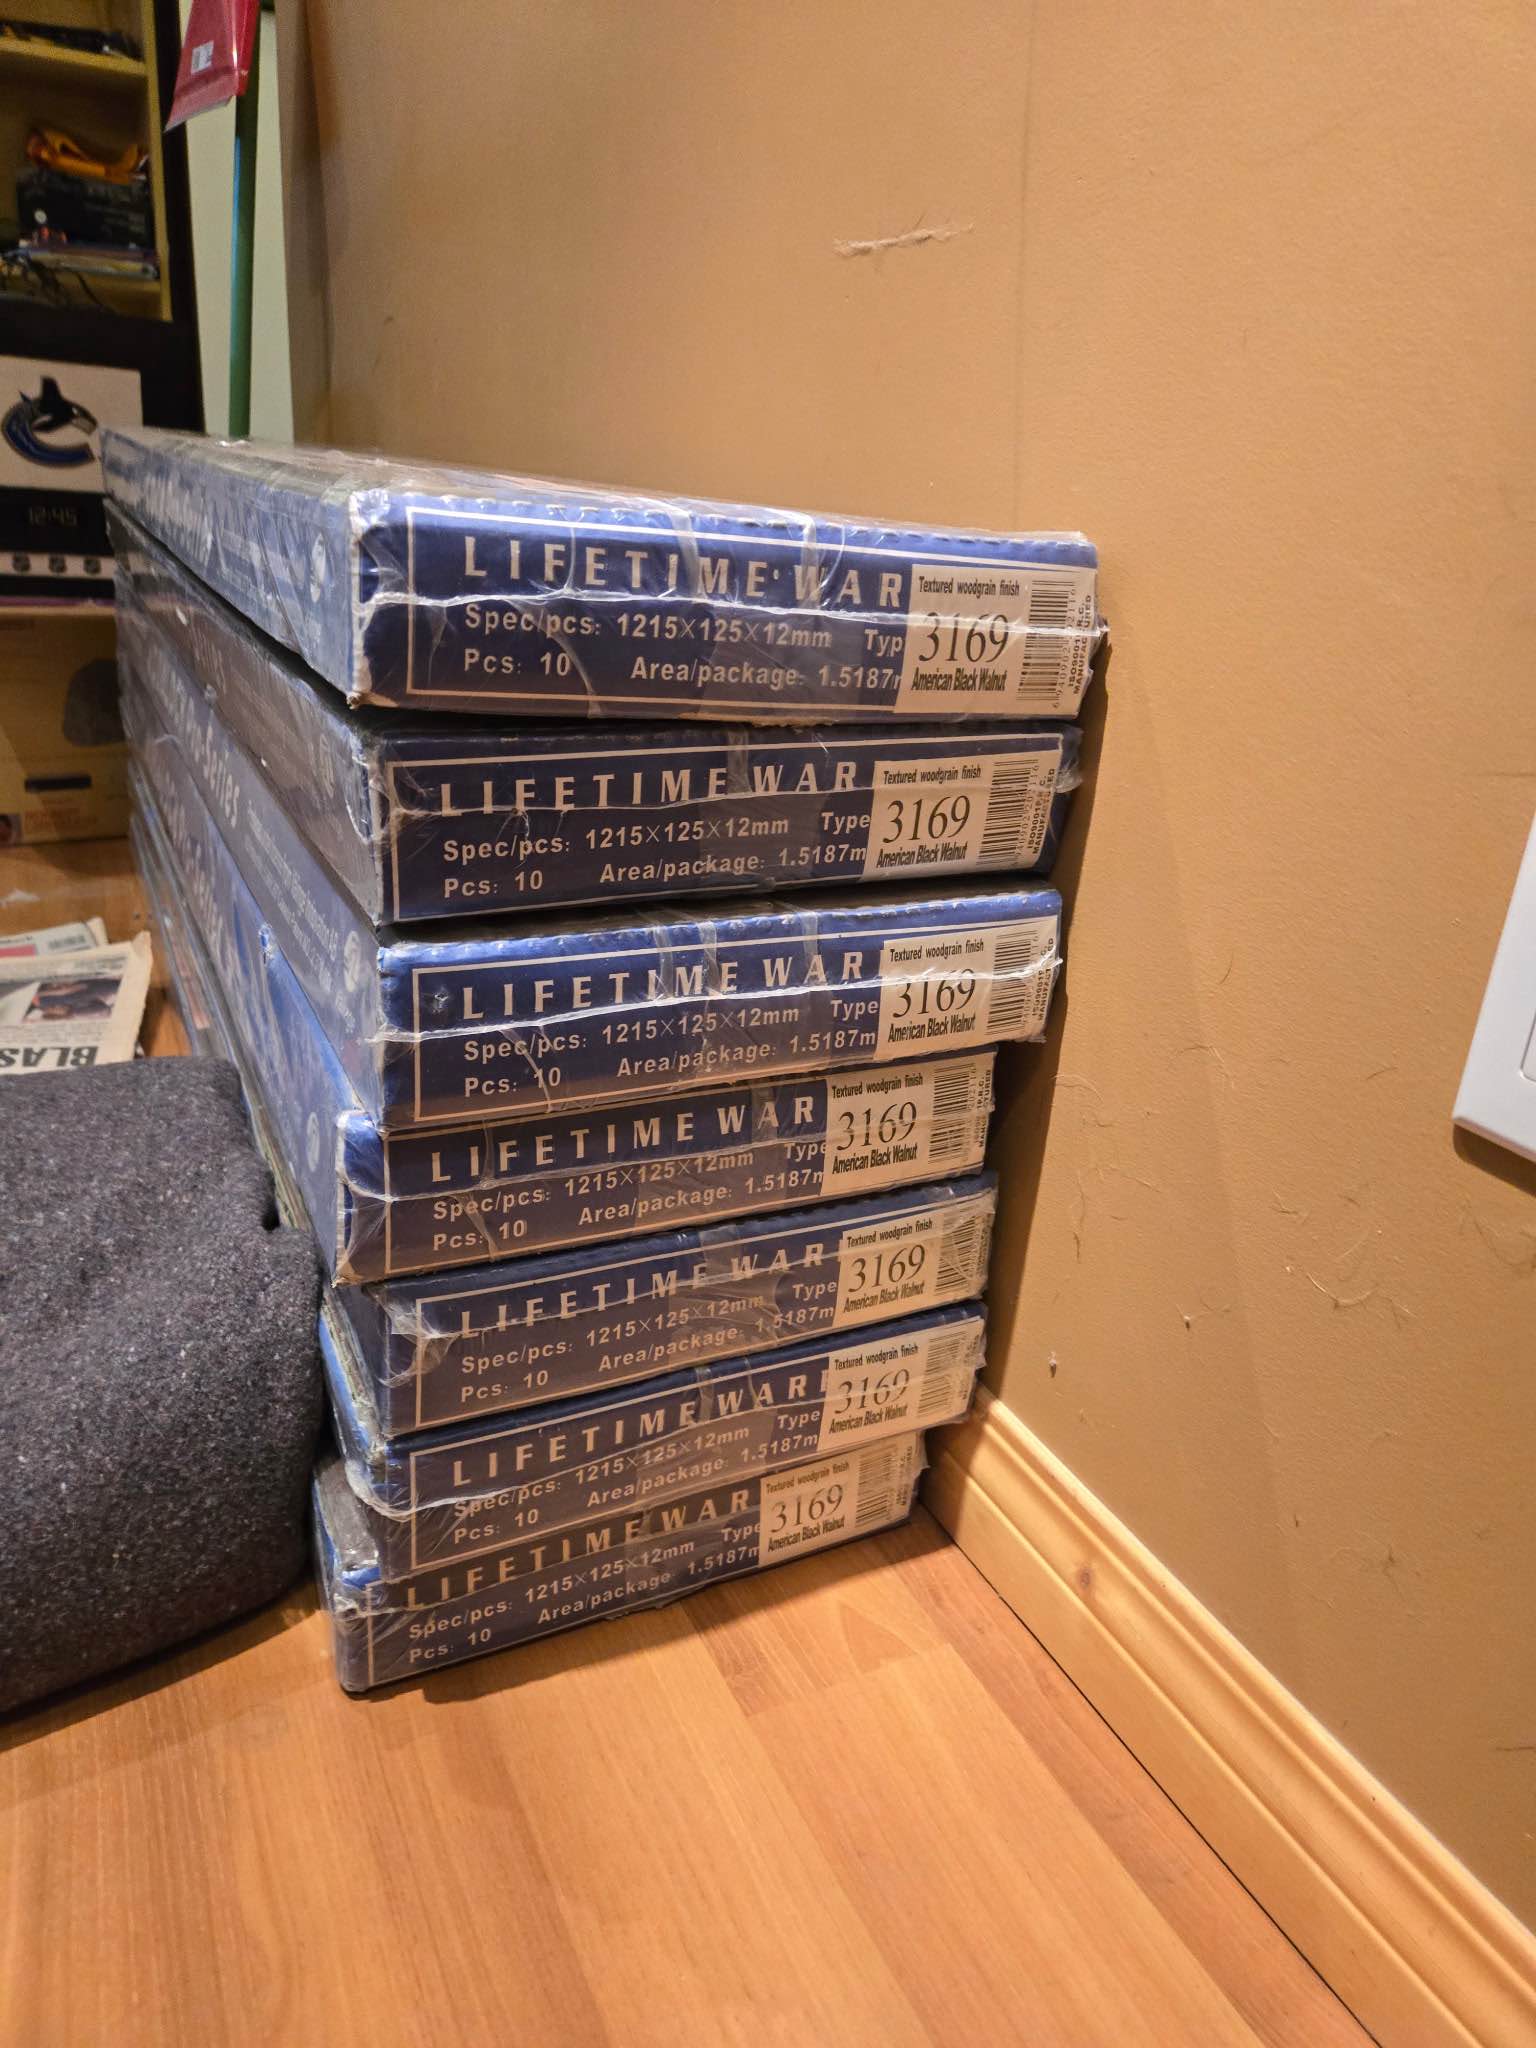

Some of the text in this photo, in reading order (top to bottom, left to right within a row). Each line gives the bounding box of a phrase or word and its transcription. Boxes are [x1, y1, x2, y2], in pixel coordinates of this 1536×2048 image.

[464, 536, 903, 608] LIFETIME WAR
[918, 576, 1020, 599] Textured woodgrain finish
[464, 604, 600, 635] Spec/pcs:
[918, 611, 1009, 663] 3169
[1073, 595, 1091, 695] MANUFACURED
[464, 648, 522, 675] Pcs:
[539, 651, 572, 677] 10
[630, 659, 805, 689] Area/package:
[910, 667, 1008, 692] American Black Walnut
[440, 761, 857, 816] LIFETIME WAR
[883, 766, 982, 785] Textured woodgrain finish
[442, 834, 570, 866] Spec/pcs:
[821, 811, 872, 834] Type
[882, 795, 972, 844] 3169
[444, 877, 498, 898] Pcs:
[514, 870, 543, 892] 10
[599, 853, 765, 884] Area/package:
[876, 842, 968, 868] American Black Walnut
[889, 940, 985, 962] Textured woodgrain finish
[462, 951, 864, 1020] LIFETIME WAR
[892, 968, 977, 1019] 3169
[463, 1032, 588, 1063] Spec/pcs:
[830, 999, 880, 1022] Type
[888, 1014, 976, 1043] American Black Walnut
[464, 1076, 518, 1098] Pcs:
[534, 1067, 562, 1088] 10
[616, 1043, 777, 1077] Area/package:
[831, 1073, 924, 1100] Textured woodgrain finish
[431, 1095, 814, 1182] LIFETIME WAR
[836, 1101, 918, 1152] 3169
[832, 1145, 919, 1175] American Black Walnut
[432, 1190, 551, 1220] Spec/pcs:
[432, 1232, 484, 1250] Pcs:
[498, 1219, 527, 1240] 10
[577, 1187, 733, 1226] Area/package:
[846, 1219, 933, 1248] Textured woodgrain finish
[461, 1243, 824, 1339] LIFETIME WAR
[847, 1244, 926, 1293] 3169
[843, 1281, 925, 1314] American Black Walnut
[461, 1338, 574, 1375] Spec/pcs:
[792, 1280, 837, 1301] Type
[461, 1384, 509, 1402] Pcs:
[523, 1370, 548, 1389] 10
[598, 1327, 742, 1372] Area/package:
[833, 1344, 919, 1371] Textured woodgrain finish
[834, 1368, 910, 1415] 3169
[777, 1408, 821, 1431] Type
[828, 1404, 908, 1435] American Black Walnut
[452, 1400, 697, 1488] LIFETIME
[766, 1461, 850, 1495] Textured woodgrain finish
[454, 1524, 501, 1544] Pcs:
[514, 1509, 540, 1527] 10
[769, 1484, 843, 1534] 3169
[407, 1488, 749, 1609] LIFETIME WAR
[767, 1513, 846, 1553] American Black Walnut
[408, 1600, 513, 1638] Spec/pcs:
[467, 1627, 493, 1647] 10
